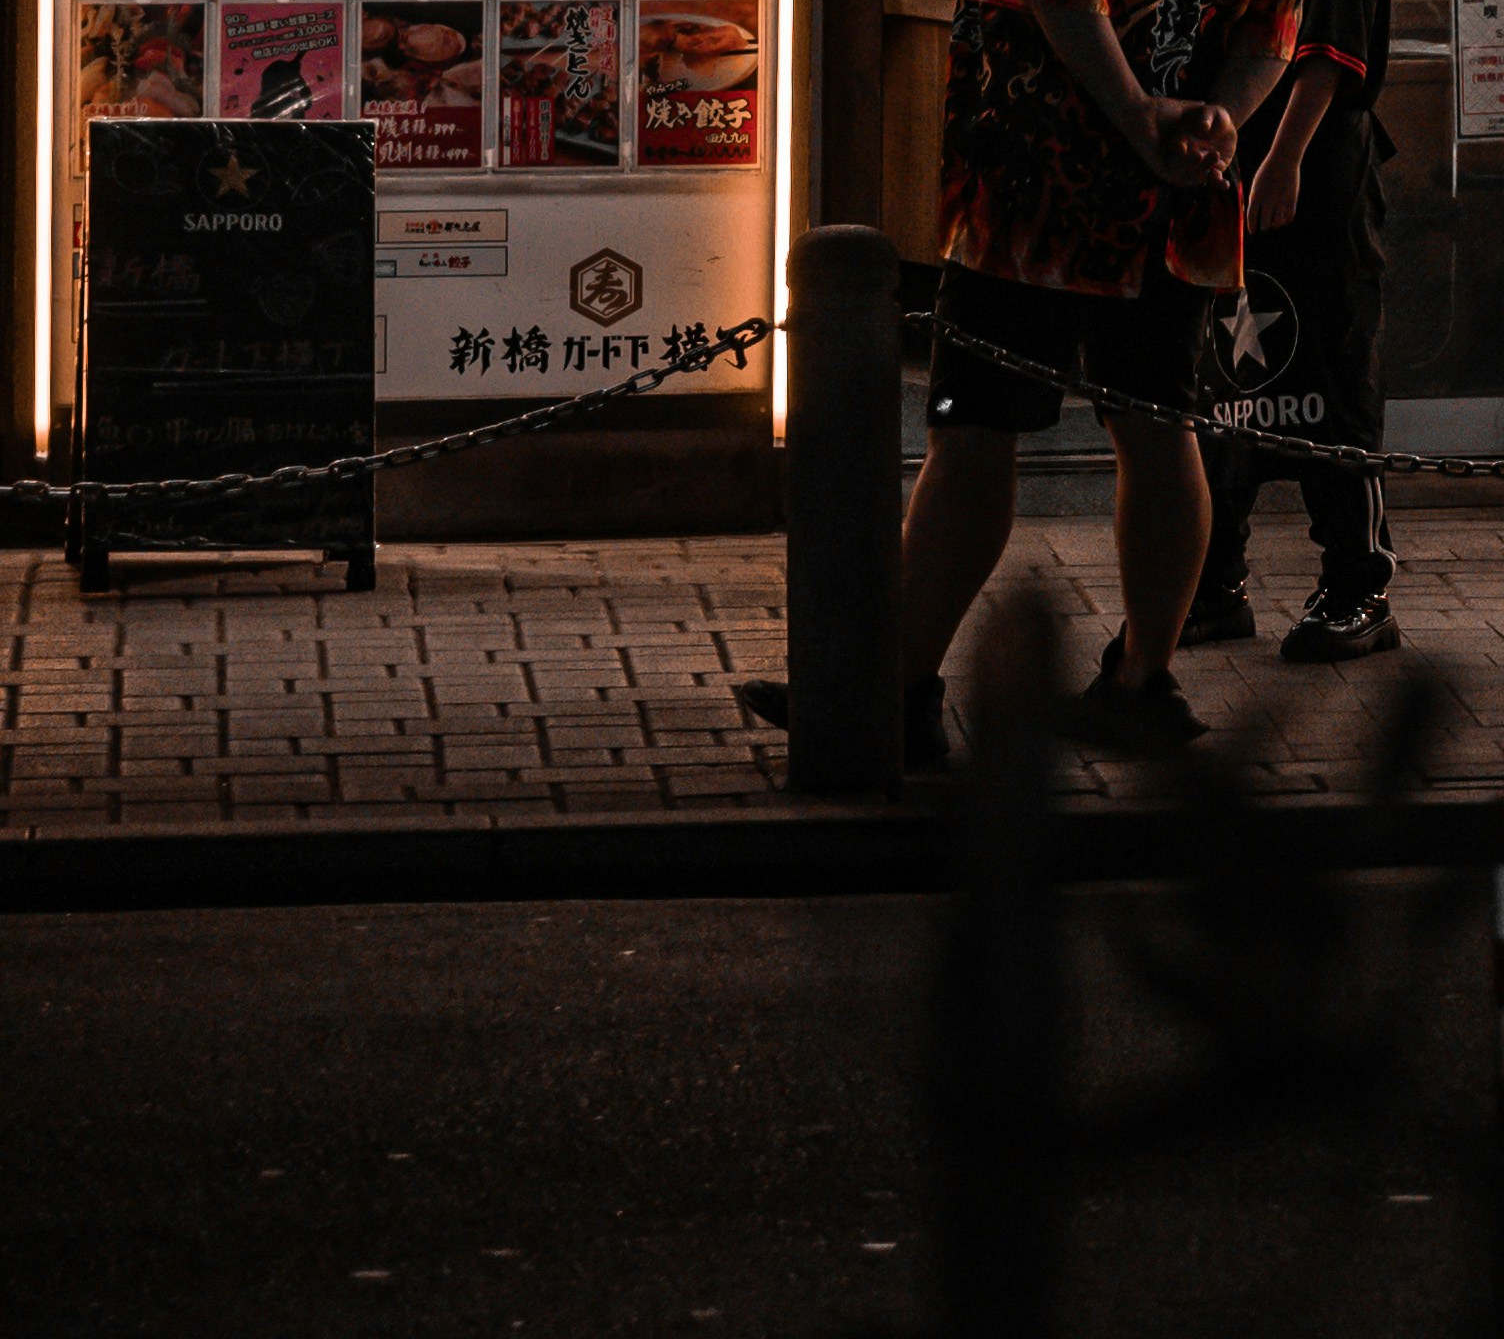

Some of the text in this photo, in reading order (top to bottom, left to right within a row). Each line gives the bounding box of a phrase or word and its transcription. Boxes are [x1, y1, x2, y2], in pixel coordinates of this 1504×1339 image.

[566, 6, 591, 100] 焼きとん
[646, 98, 752, 129] 焼き餃子
[184, 213, 283, 231] SAPPORO
[1212, 391, 1326, 430] SAPPORO
